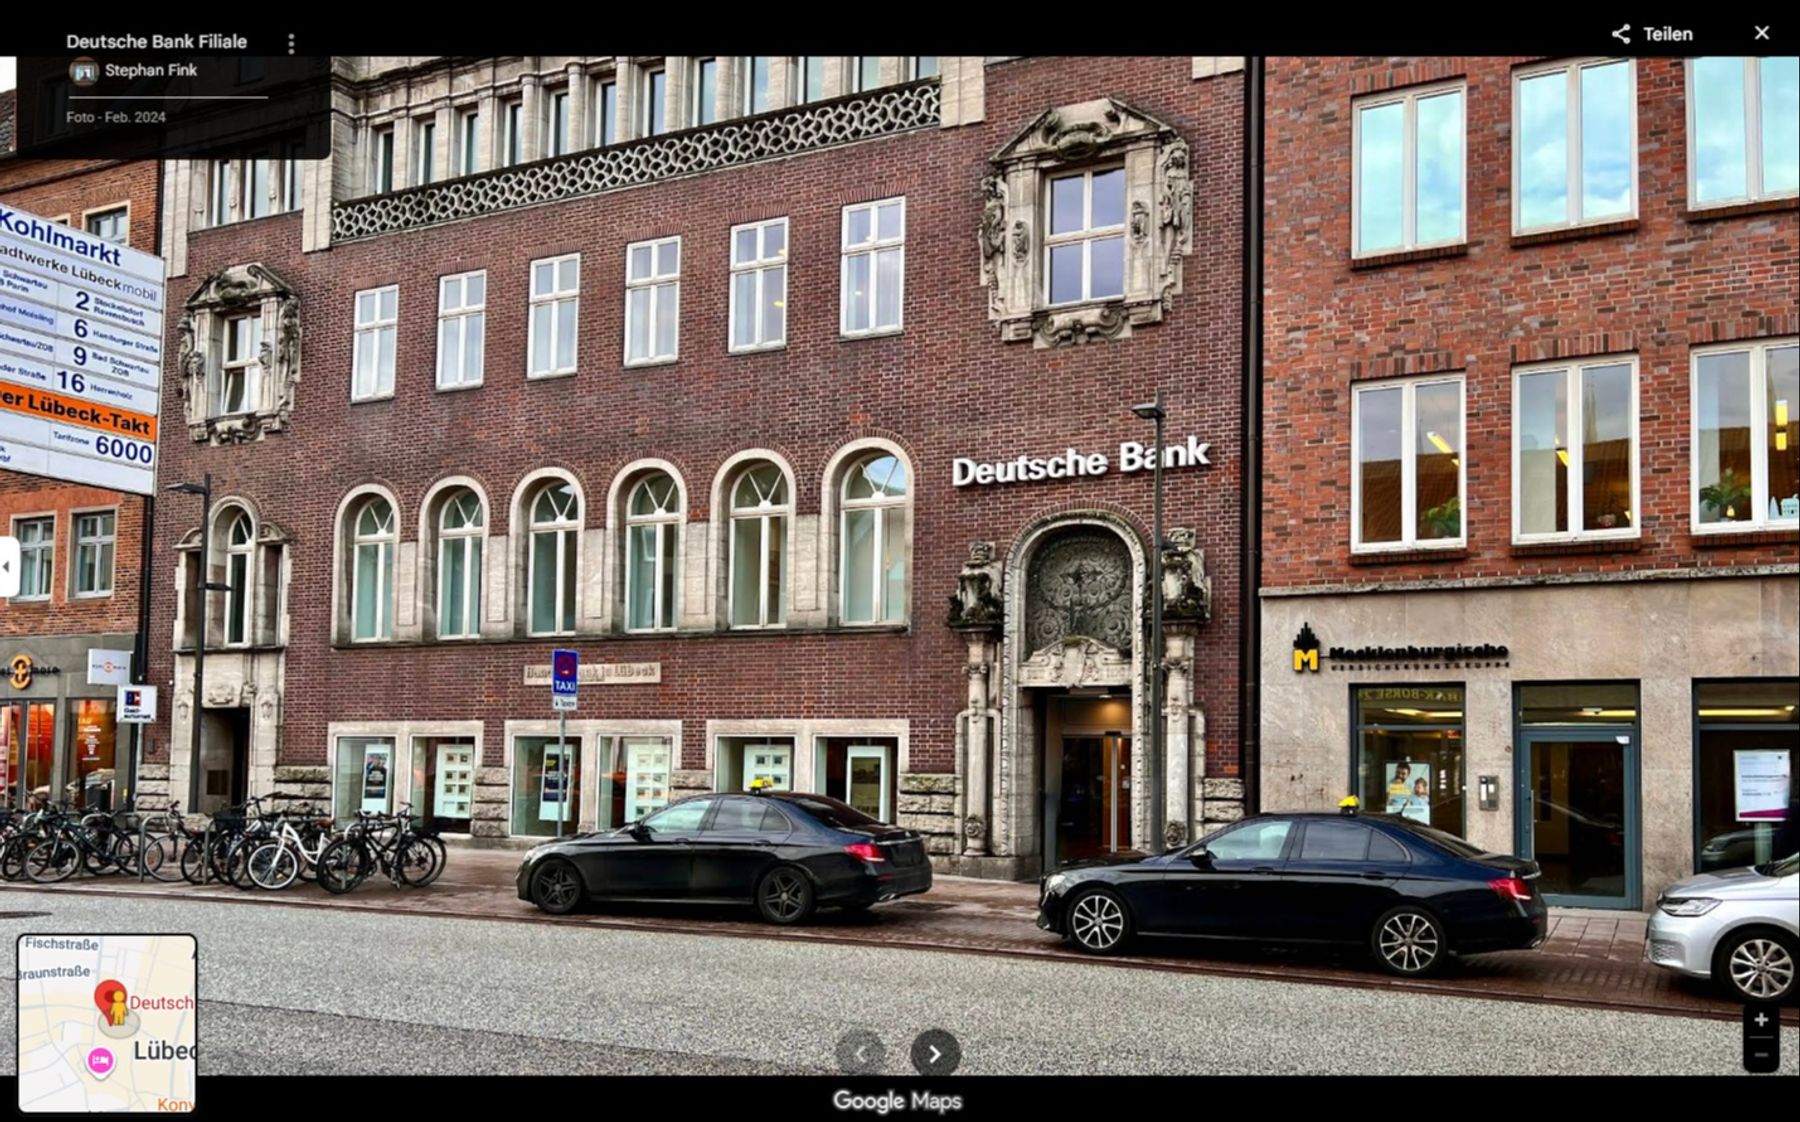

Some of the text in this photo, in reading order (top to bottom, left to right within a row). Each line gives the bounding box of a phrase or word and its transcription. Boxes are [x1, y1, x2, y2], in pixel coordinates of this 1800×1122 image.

[0, 208, 121, 267] Kohlmarkt
[75, 290, 90, 312] 2
[74, 318, 88, 339] 6
[73, 345, 87, 367] 9
[57, 370, 86, 394] 16
[0, 391, 150, 436] er Lübeck-Takt
[95, 435, 153, 464] 6000
[952, 435, 1212, 488] Deutsche Bank
[1294, 649, 1319, 672] M
[1329, 643, 1510, 661] Mecklenburgische
[555, 680, 576, 692] TAXI
